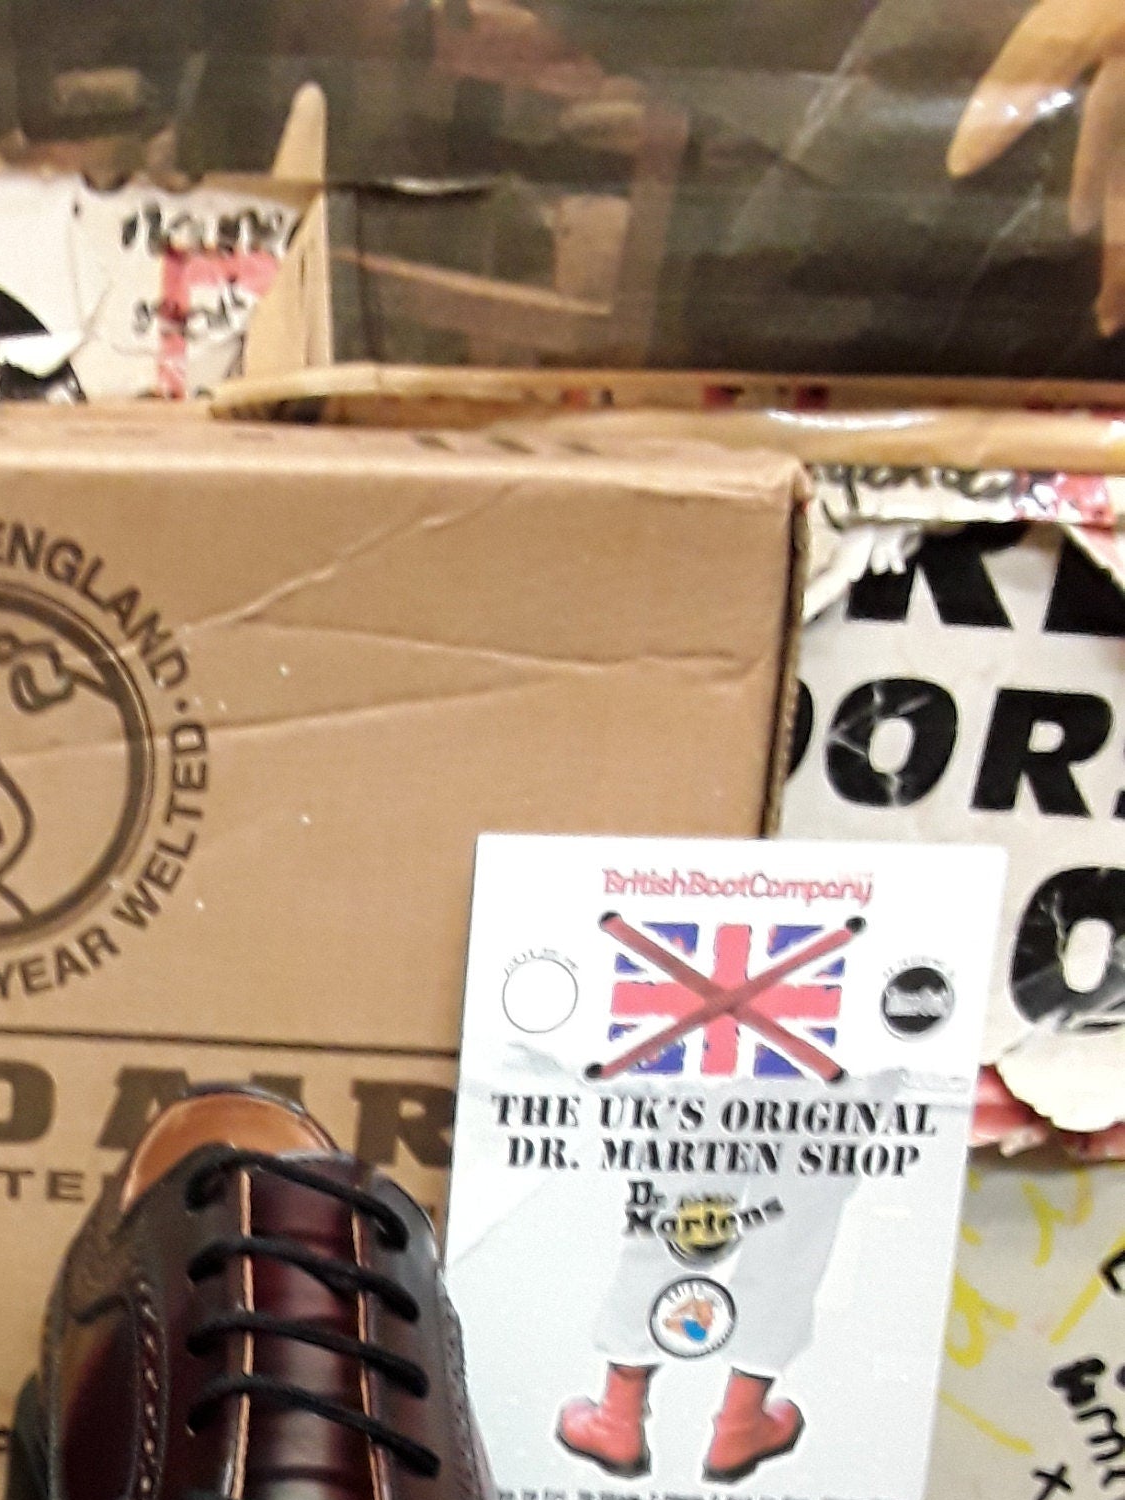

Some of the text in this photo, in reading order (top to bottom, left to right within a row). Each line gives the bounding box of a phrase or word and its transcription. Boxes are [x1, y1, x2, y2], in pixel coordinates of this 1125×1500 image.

[112, 722, 208, 930] WELTED
[602, 867, 873, 906] BritishBootCompany
[490, 1095, 937, 1137] THE UK'S ORIGINAL
[506, 1136, 922, 1177] DR. MARTEN SHOP
